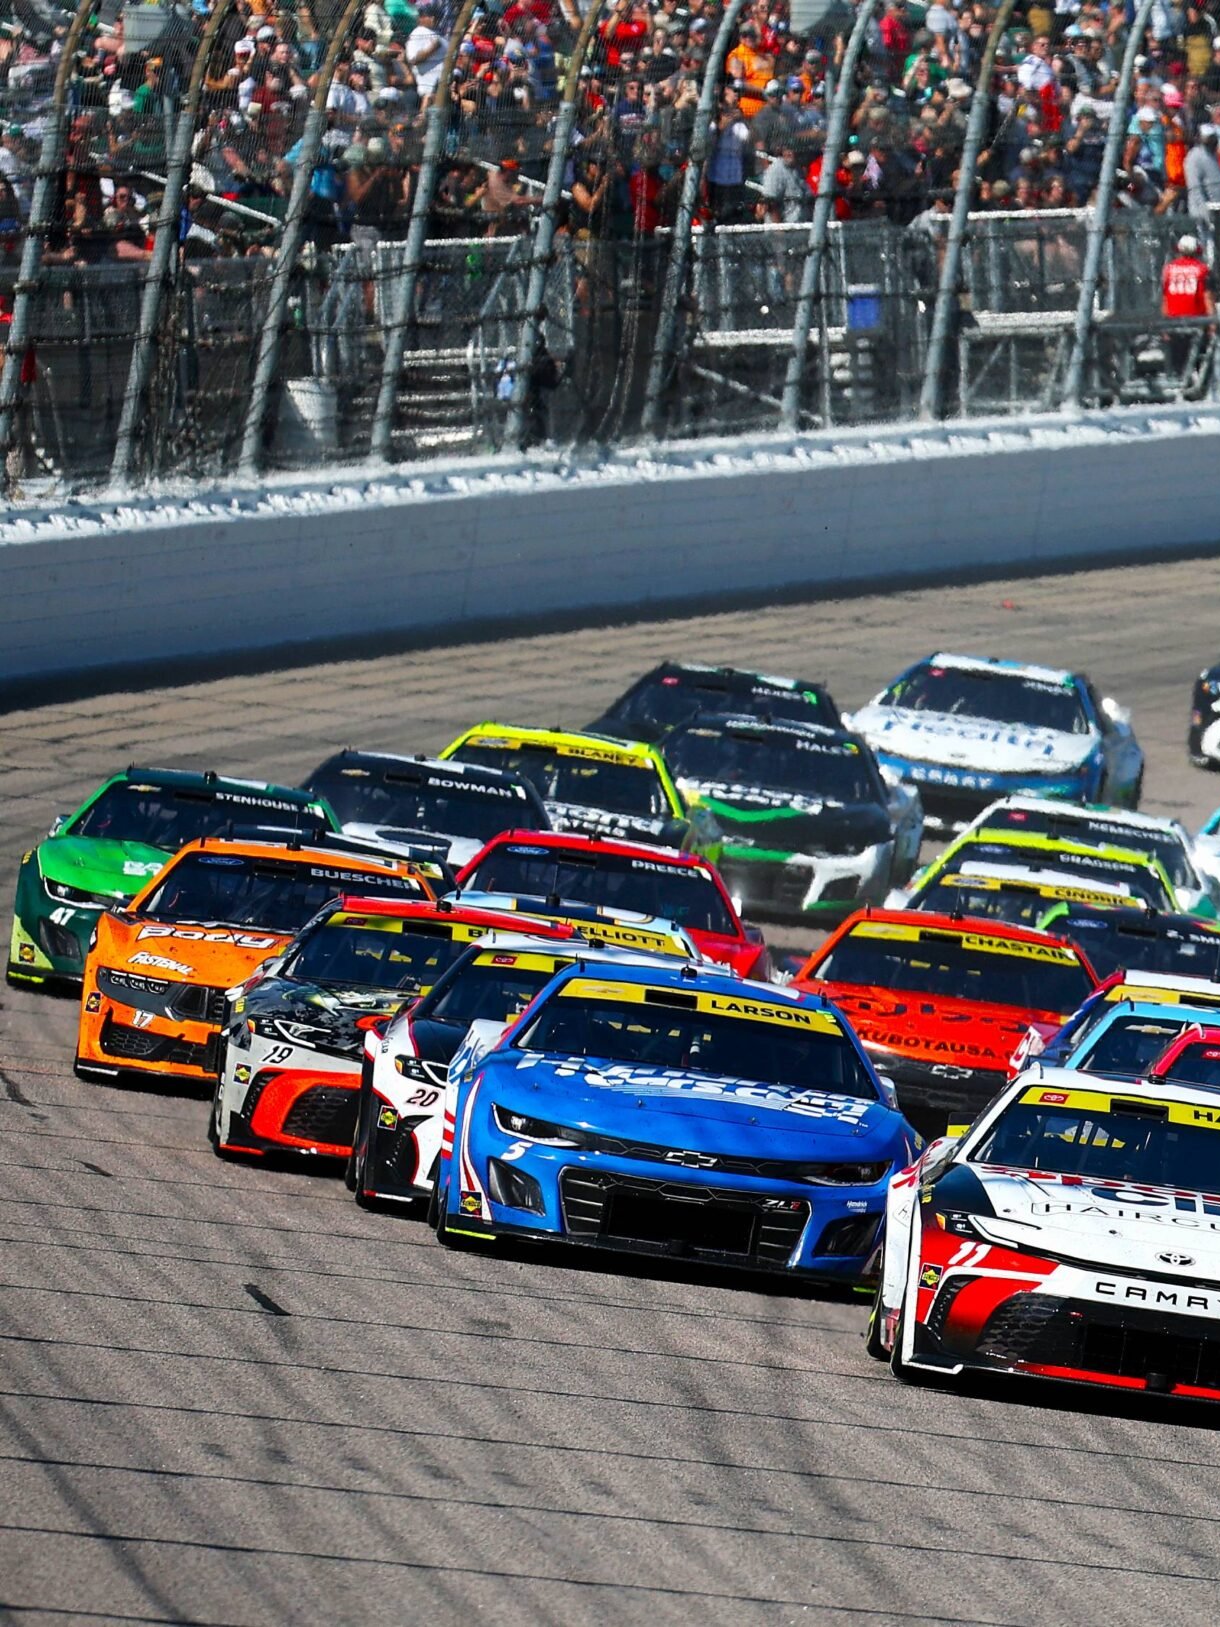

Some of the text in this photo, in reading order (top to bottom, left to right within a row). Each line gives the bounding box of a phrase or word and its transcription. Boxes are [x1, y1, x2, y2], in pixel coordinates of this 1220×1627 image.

[428, 777, 512, 798] BOWMAN
[215, 792, 299, 812] STENHOUSE
[631, 860, 698, 878] PREECE
[49, 907, 76, 926] 47
[577, 926, 665, 947] ELLIOTT
[132, 1010, 156, 1028] 17
[711, 1000, 811, 1025] LARSON
[261, 1045, 294, 1064] 19
[405, 1088, 440, 1107] 20
[500, 1141, 533, 1161] 5
[948, 1240, 993, 1267] 11
